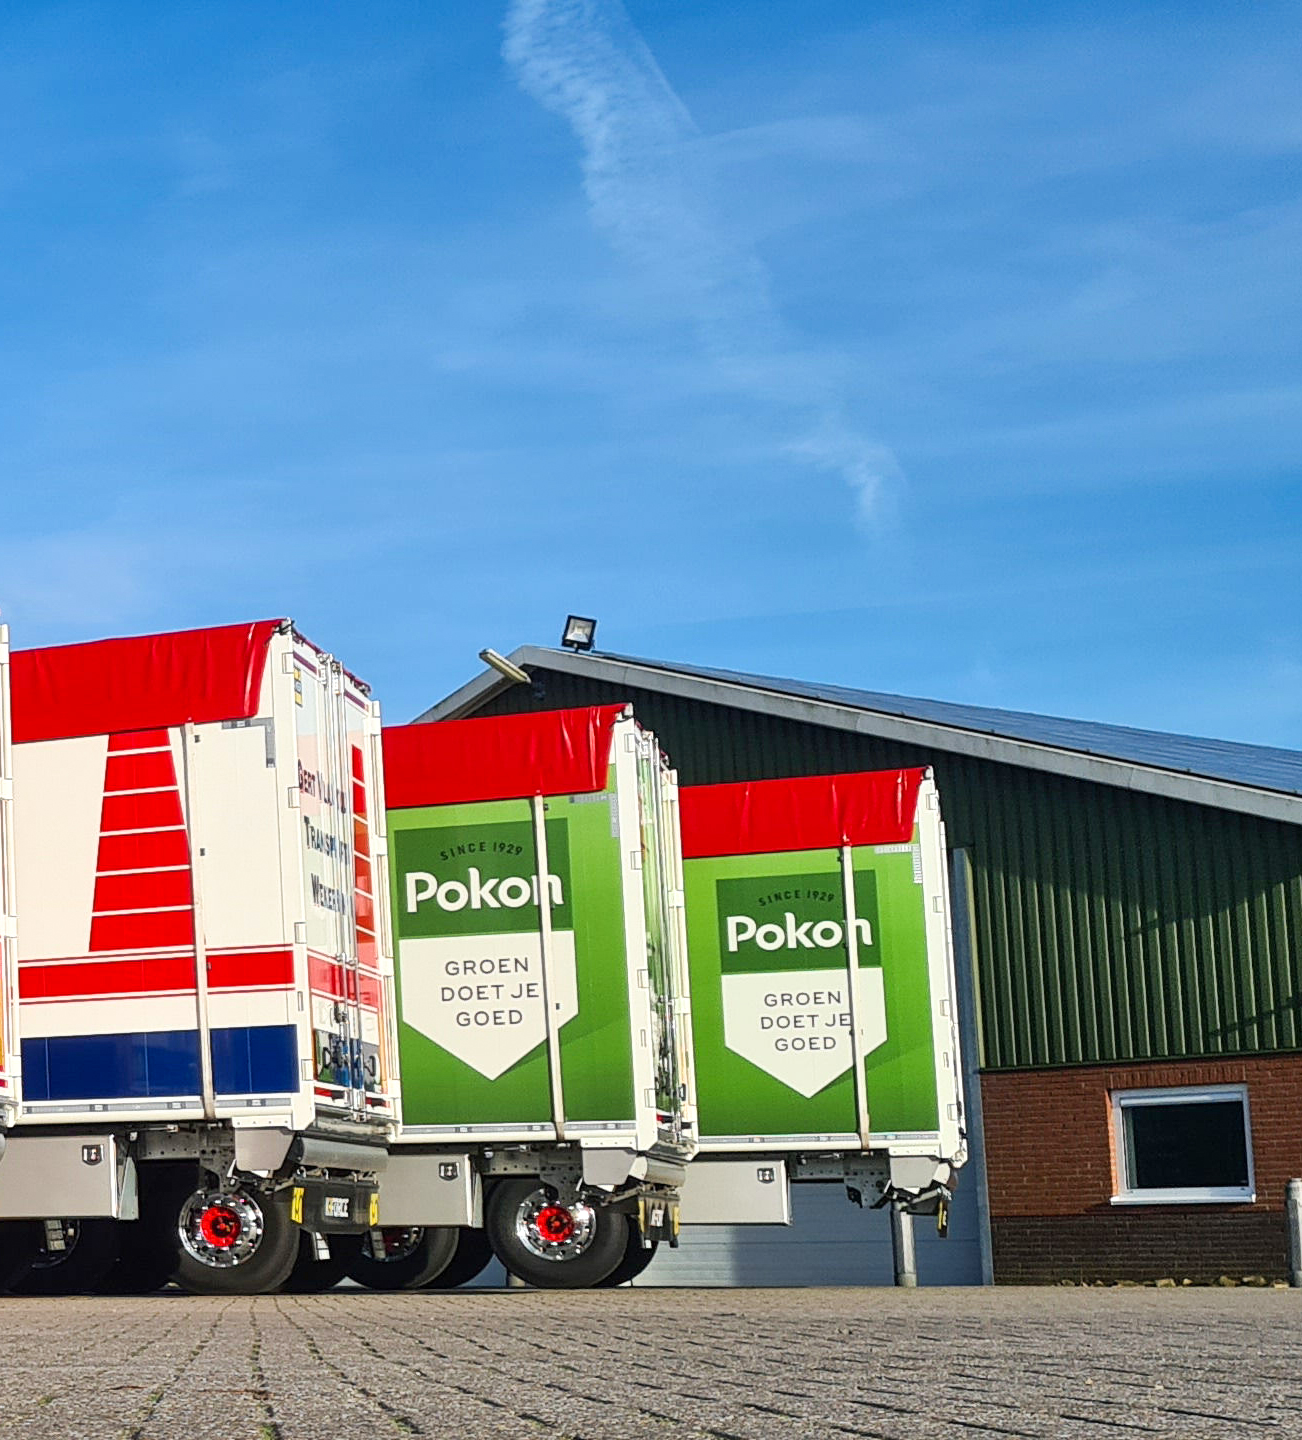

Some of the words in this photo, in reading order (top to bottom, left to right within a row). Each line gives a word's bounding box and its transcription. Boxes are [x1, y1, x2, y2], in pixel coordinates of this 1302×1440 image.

[440, 841, 487, 861] SINCE
[492, 841, 523, 856] 1929
[405, 867, 565, 913] Pokon
[758, 889, 800, 907] SINCE
[807, 889, 835, 902] 1929
[445, 957, 529, 976] GROEN
[441, 984, 505, 1002] DOET
[510, 982, 539, 999] JE
[764, 990, 842, 1007] GROEN
[456, 1009, 523, 1027] GOED
[760, 1014, 820, 1030] DOET
[824, 1013, 852, 1028] JE
[774, 1036, 837, 1052] GOED
